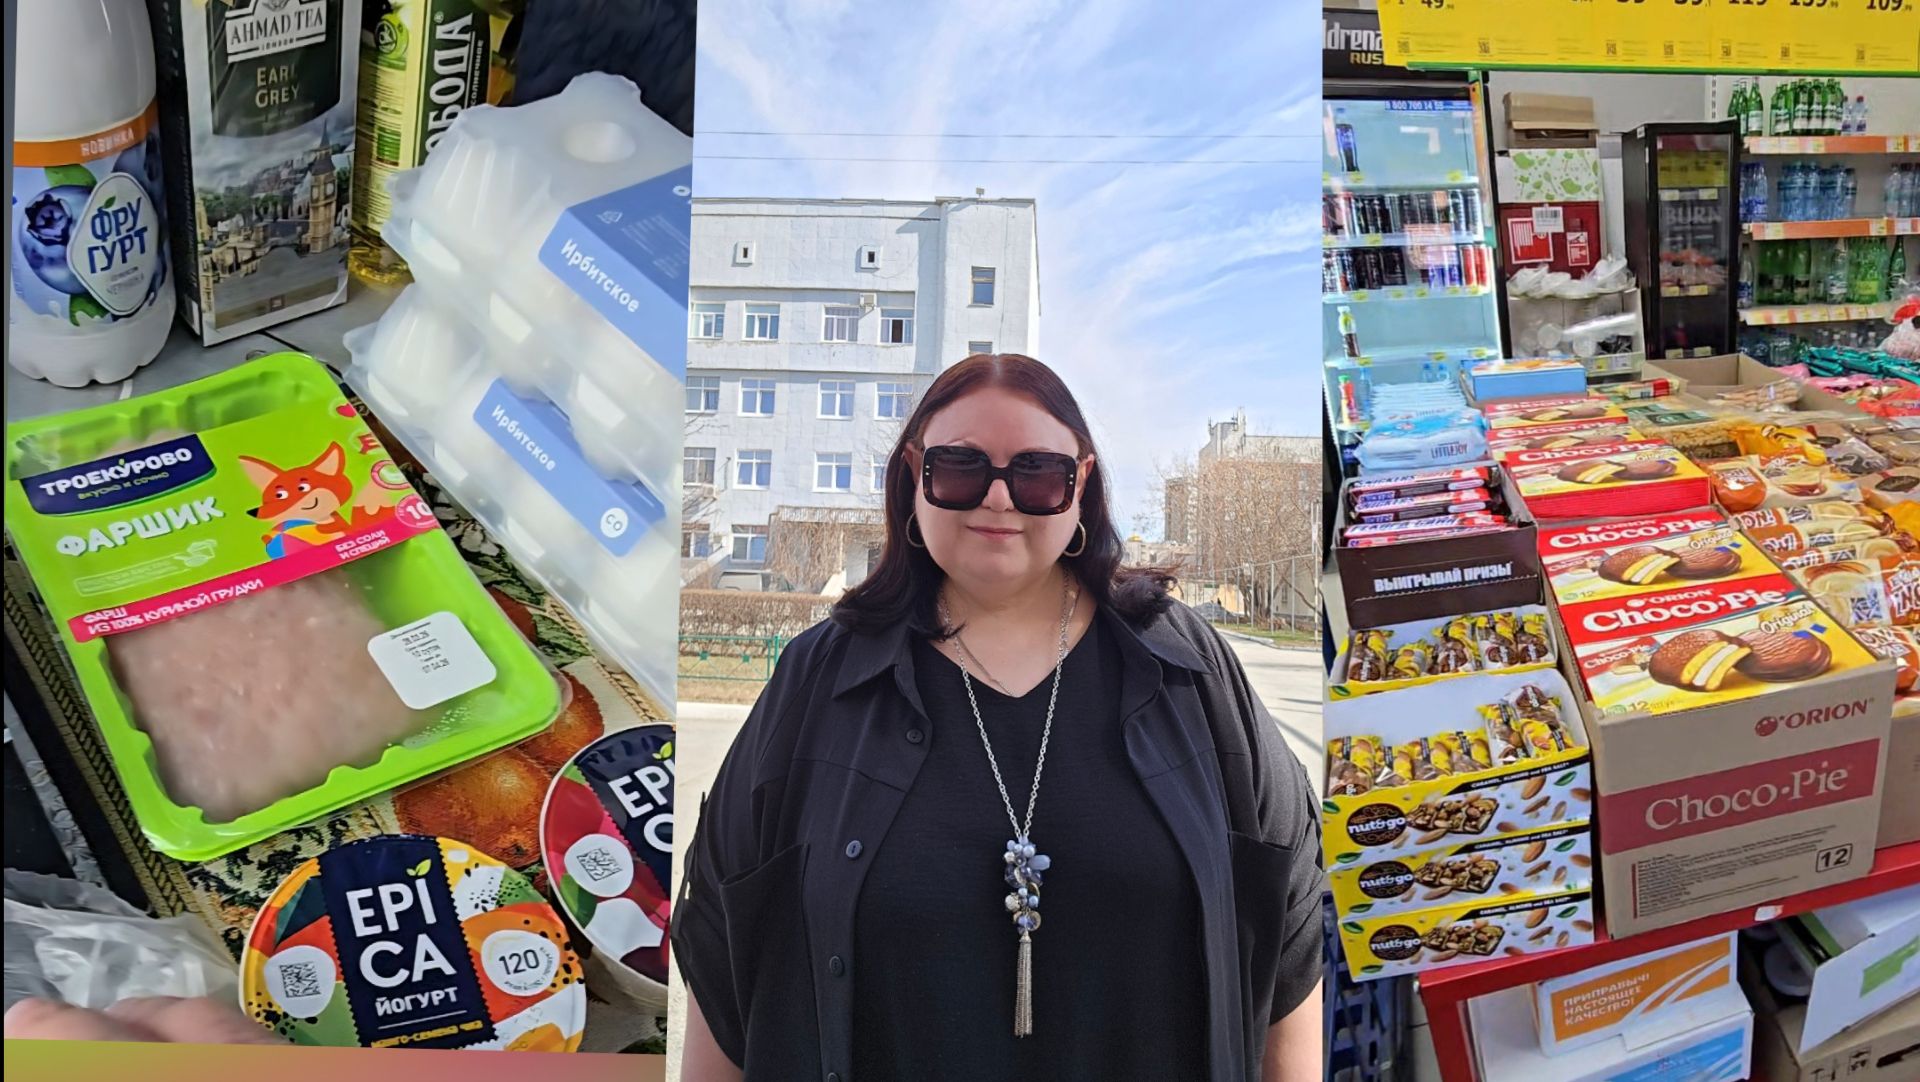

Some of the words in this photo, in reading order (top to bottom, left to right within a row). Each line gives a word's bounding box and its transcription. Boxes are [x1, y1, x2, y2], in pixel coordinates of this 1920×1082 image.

[231, 14, 292, 45] AHMAD
[294, 7, 323, 31] TEA
[256, 63, 298, 88] EARL
[255, 83, 300, 108] GREY
[80, 127, 135, 156] НОВИНКА
[90, 197, 142, 243] ФРУ
[88, 226, 149, 274] ГУРТ
[561, 239, 640, 313] Ирбитское
[492, 405, 556, 471] Ирбитское
[39, 448, 193, 496] ТРОЕКУРОВО
[56, 496, 226, 557] ФАРШИК
[357, 530, 386, 545] СОЛИ
[1374, 567, 1463, 593] ВЫИГРЫВАЙ
[88, 622, 111, 635] ИЗ
[143, 593, 212, 622] КУРИНОЙ
[210, 579, 265, 603] ГРУДКИ
[1650, 589, 1713, 605] ORION
[83, 607, 128, 624] ФАРШ
[1760, 601, 1814, 634] Original
[1786, 700, 1869, 729] ORION
[1348, 815, 1406, 836] nut&go
[1820, 848, 1849, 869] 12
[1359, 871, 1414, 890] nut&go
[1370, 935, 1421, 953] nut&go
[359, 933, 458, 988] CA
[498, 948, 540, 976] 120
[375, 986, 459, 1017] ЙОГУРТ
[1565, 985, 1642, 1017] НАСТОЯЩЕЕ
[1565, 997, 1635, 1027] КАЧЕСТВО!
